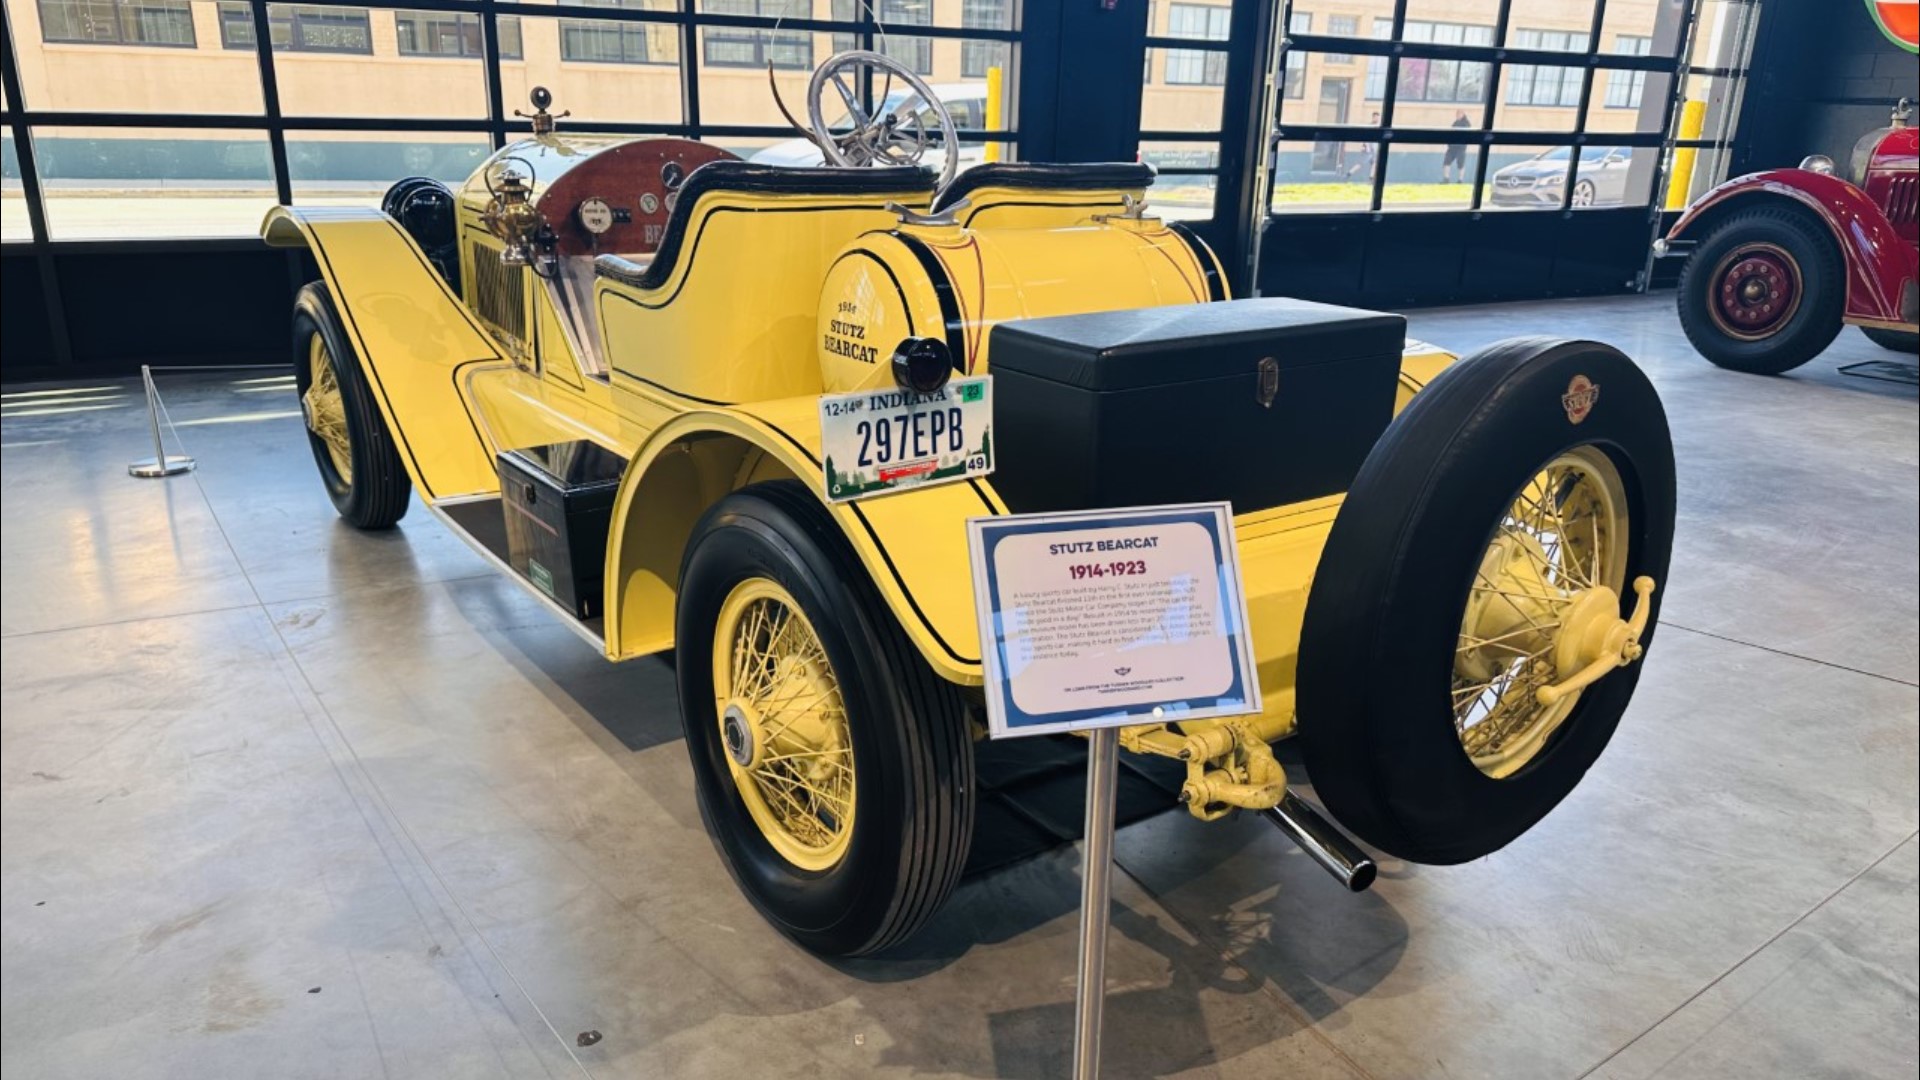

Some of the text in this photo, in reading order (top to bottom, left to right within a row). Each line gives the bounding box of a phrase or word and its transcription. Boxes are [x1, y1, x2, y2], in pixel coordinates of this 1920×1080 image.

[830, 319, 865, 340] STUTZ
[824, 334, 878, 364] BEARCAT
[825, 402, 855, 417] 12-14
[869, 390, 947, 411] INDIANA
[856, 407, 963, 467] 297EPB
[968, 457, 984, 470] 49
[1049, 537, 1159, 555] STUTZ BEARCAT
[1069, 560, 1146, 579] 1914-1923
